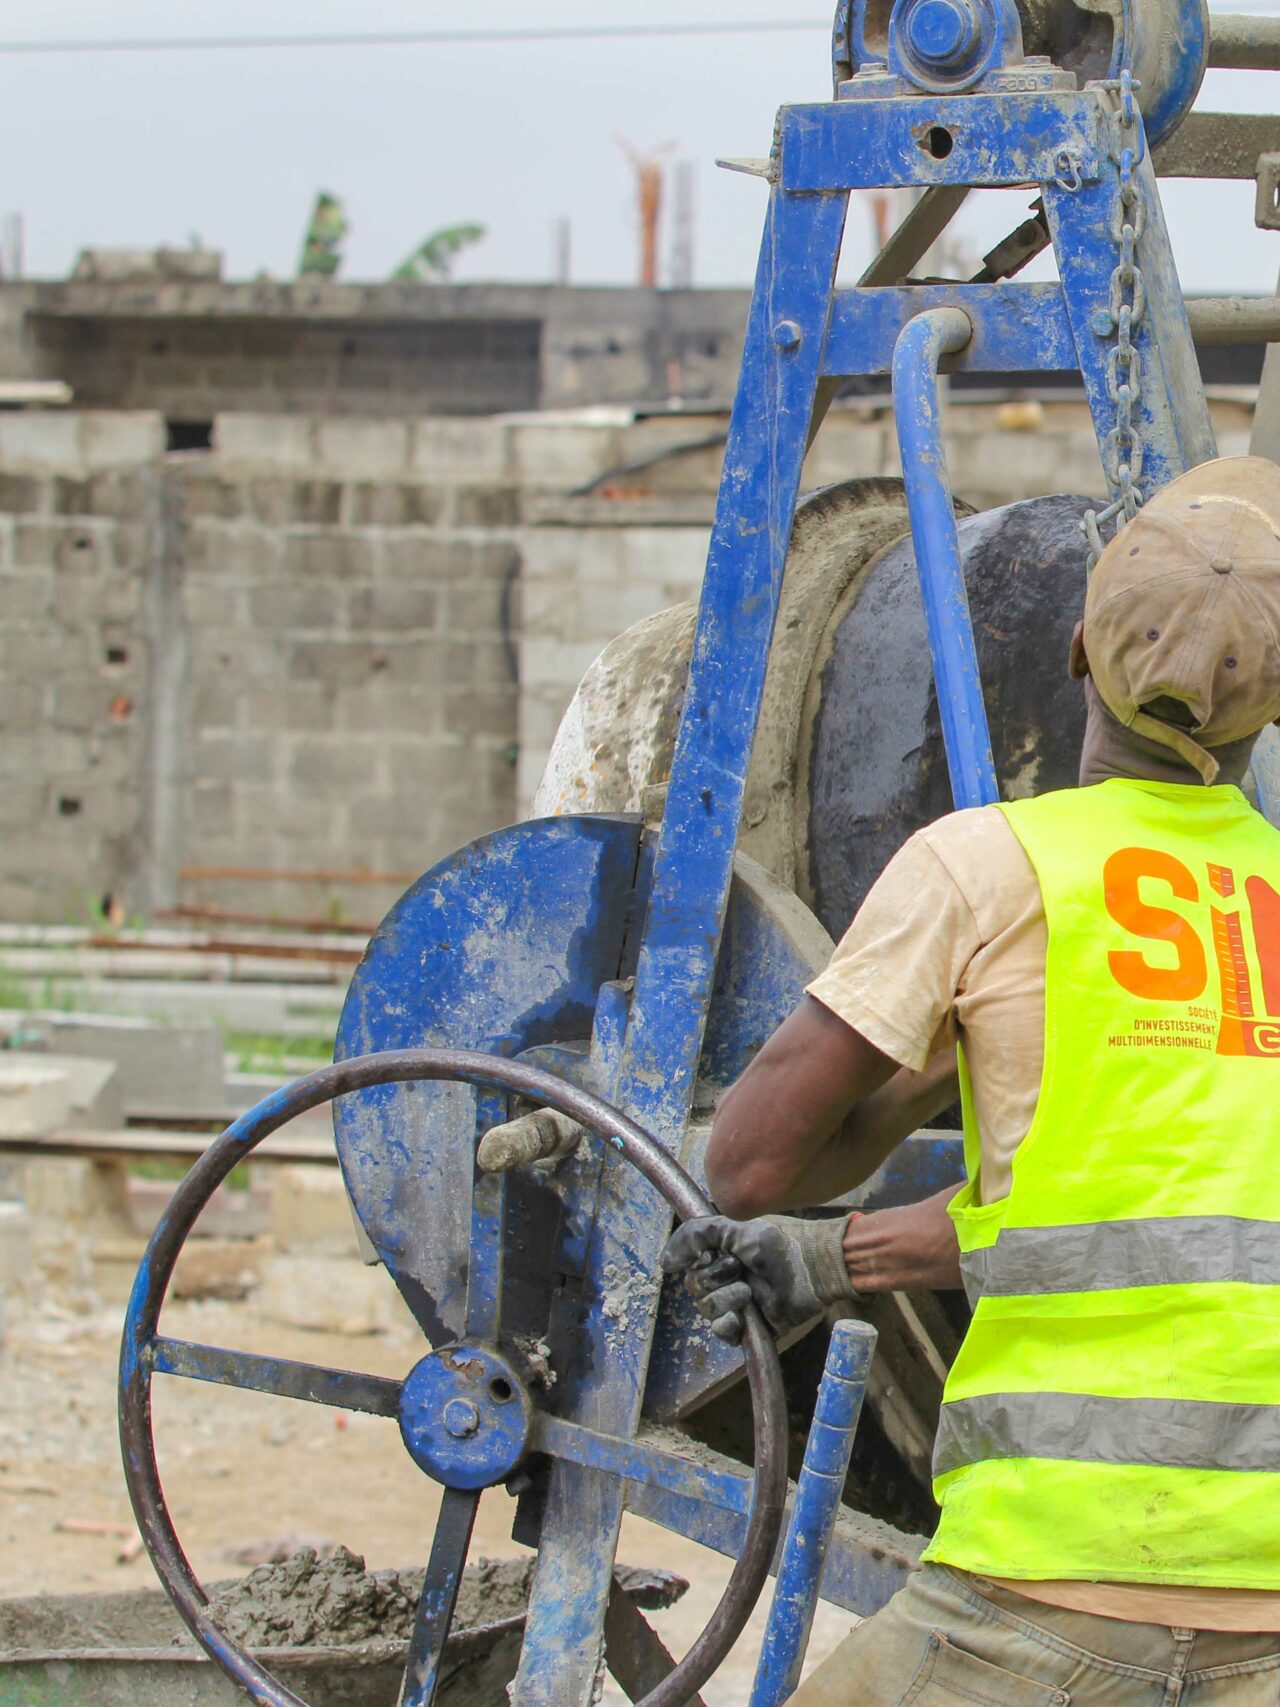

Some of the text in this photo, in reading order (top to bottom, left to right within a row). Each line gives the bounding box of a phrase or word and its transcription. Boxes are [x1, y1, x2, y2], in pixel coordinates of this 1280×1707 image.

[1188, 1006, 1218, 1021] SOCIÉTÉ
[1134, 1019, 1216, 1035] D'INVESTISSEMENT
[1108, 1036, 1212, 1050] MULTIDIMENSIONNELLE
